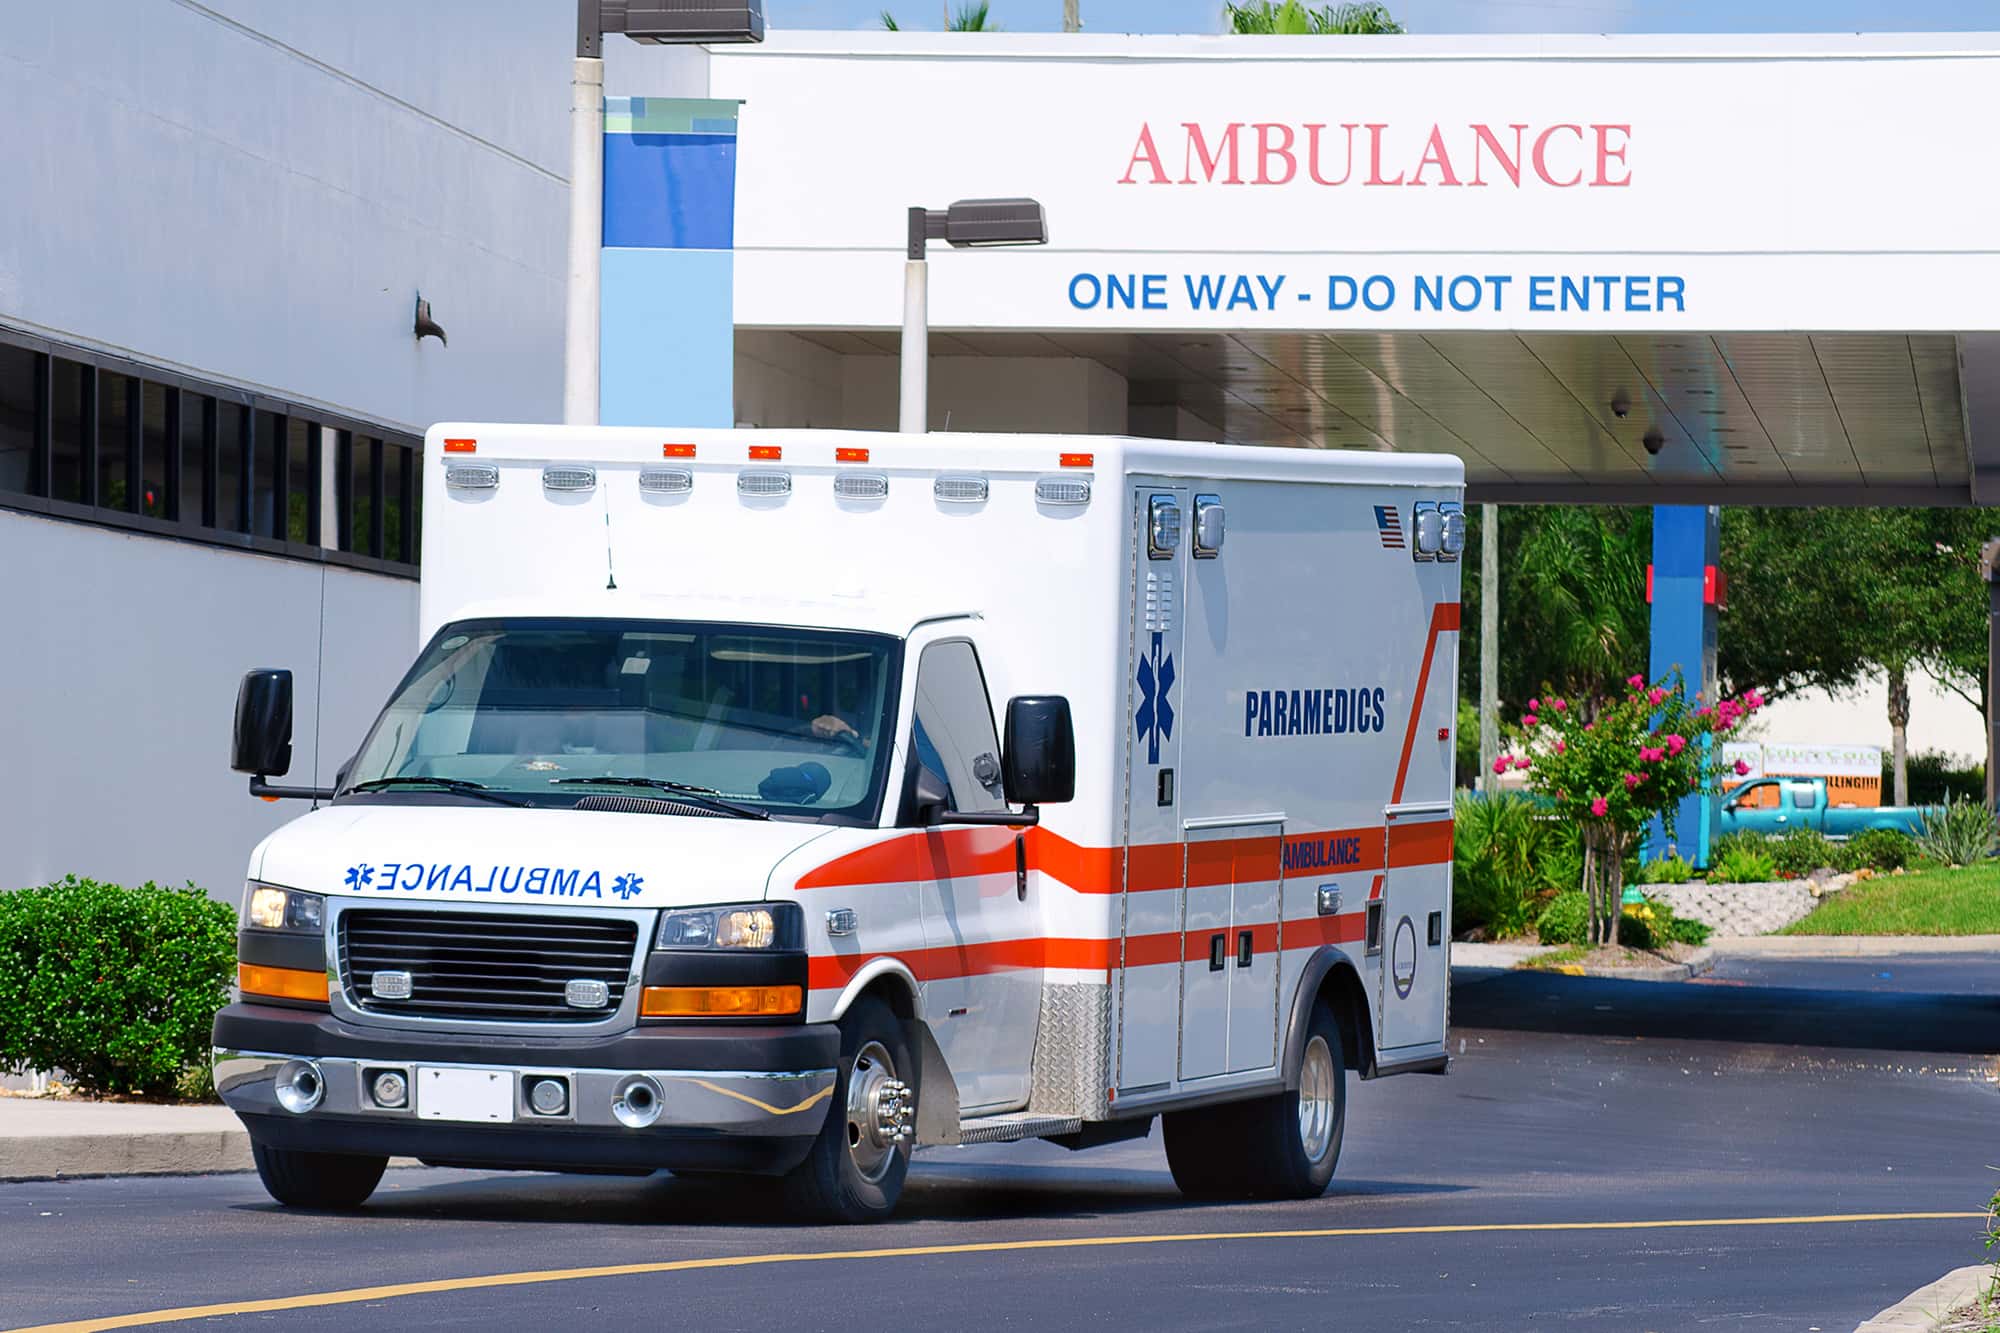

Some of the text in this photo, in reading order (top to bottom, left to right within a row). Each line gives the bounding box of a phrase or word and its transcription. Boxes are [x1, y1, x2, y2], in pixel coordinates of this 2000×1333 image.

[1118, 123, 1631, 187] AMBULANCE
[1068, 272, 1168, 310] ONE
[1184, 274, 1286, 310] WAY
[1327, 274, 1396, 312] DO
[1413, 274, 1512, 312] NOT
[1529, 275, 1686, 312] ENTER
[1245, 687, 1385, 737] PARAMEDICS
[1283, 837, 1360, 870] AMBULANCE
